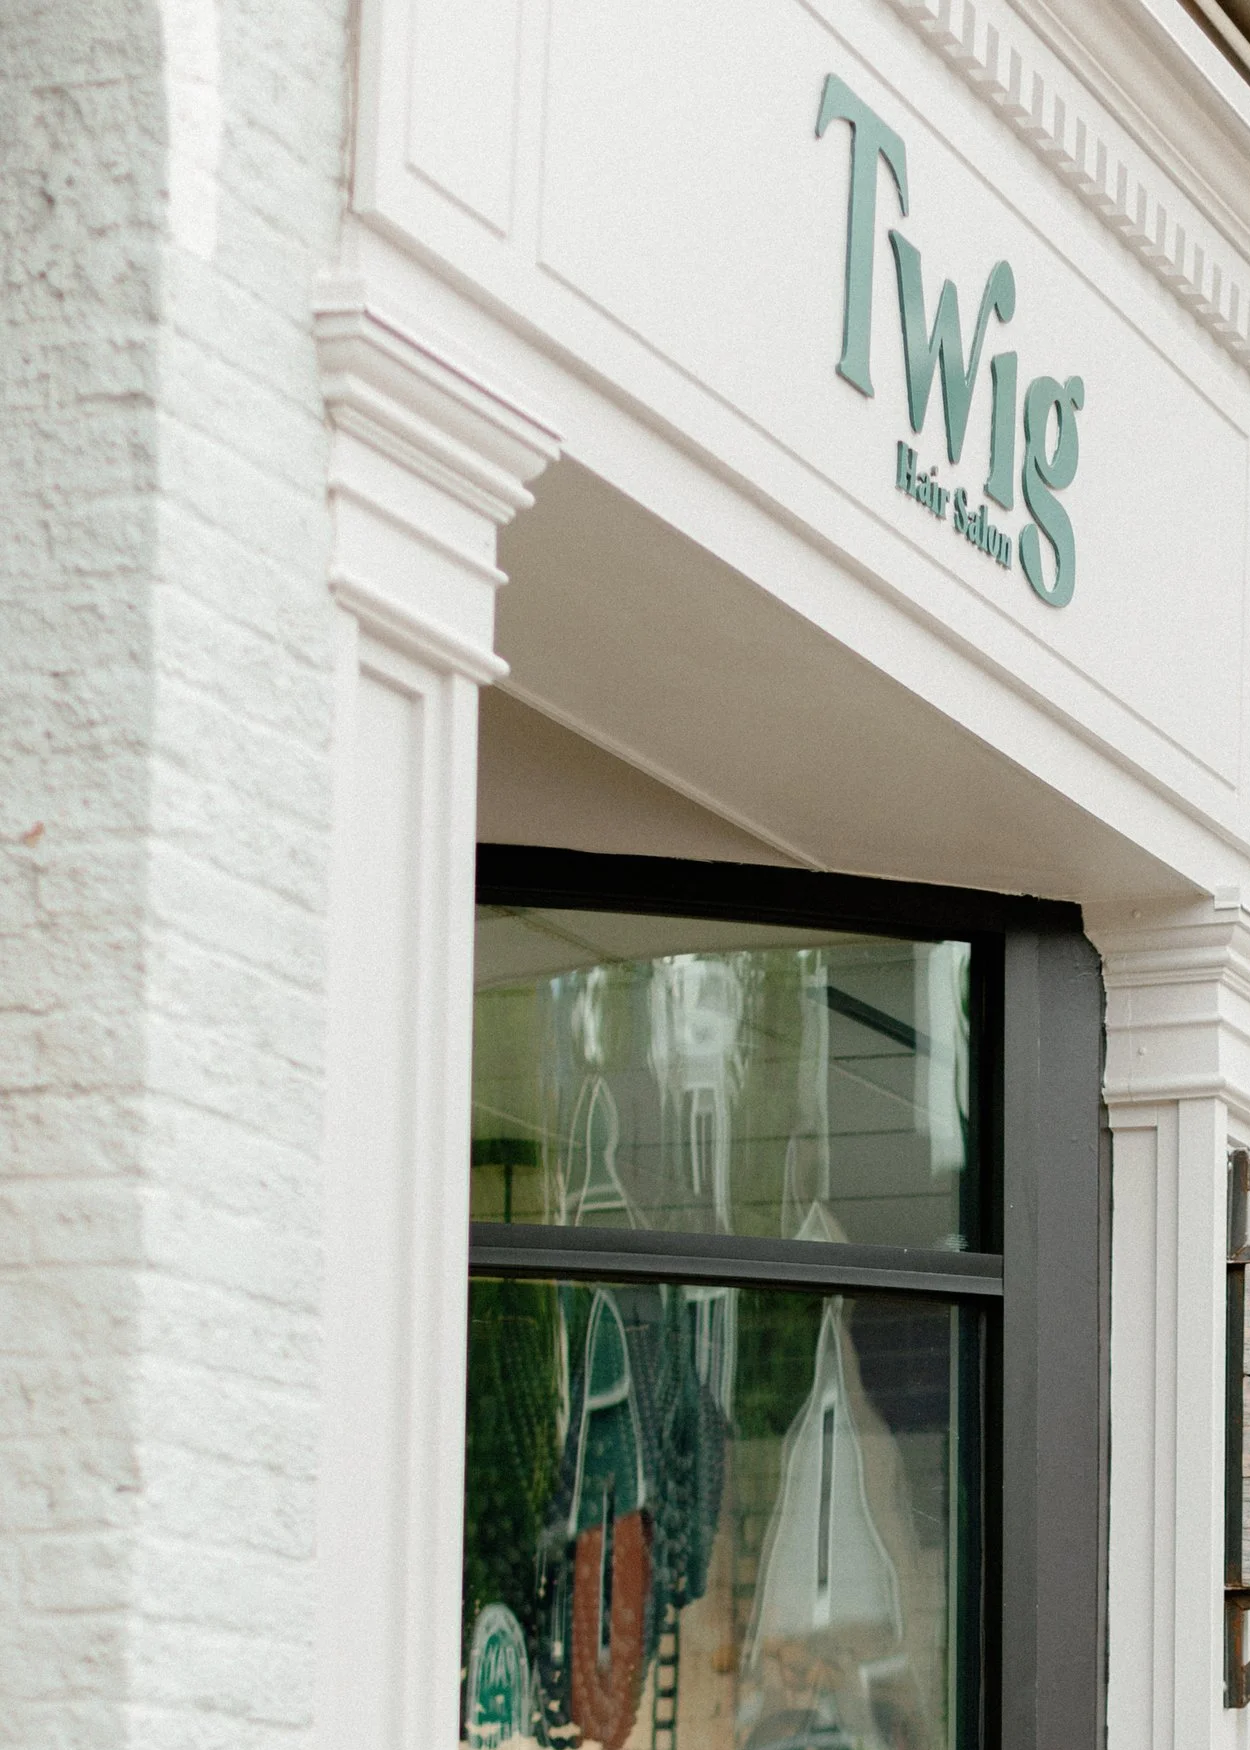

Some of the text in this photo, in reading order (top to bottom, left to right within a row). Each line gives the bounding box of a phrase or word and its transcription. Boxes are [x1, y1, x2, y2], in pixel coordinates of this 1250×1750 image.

[815, 72, 1085, 609] Twig
[895, 440, 1012, 569] Hair Salon
